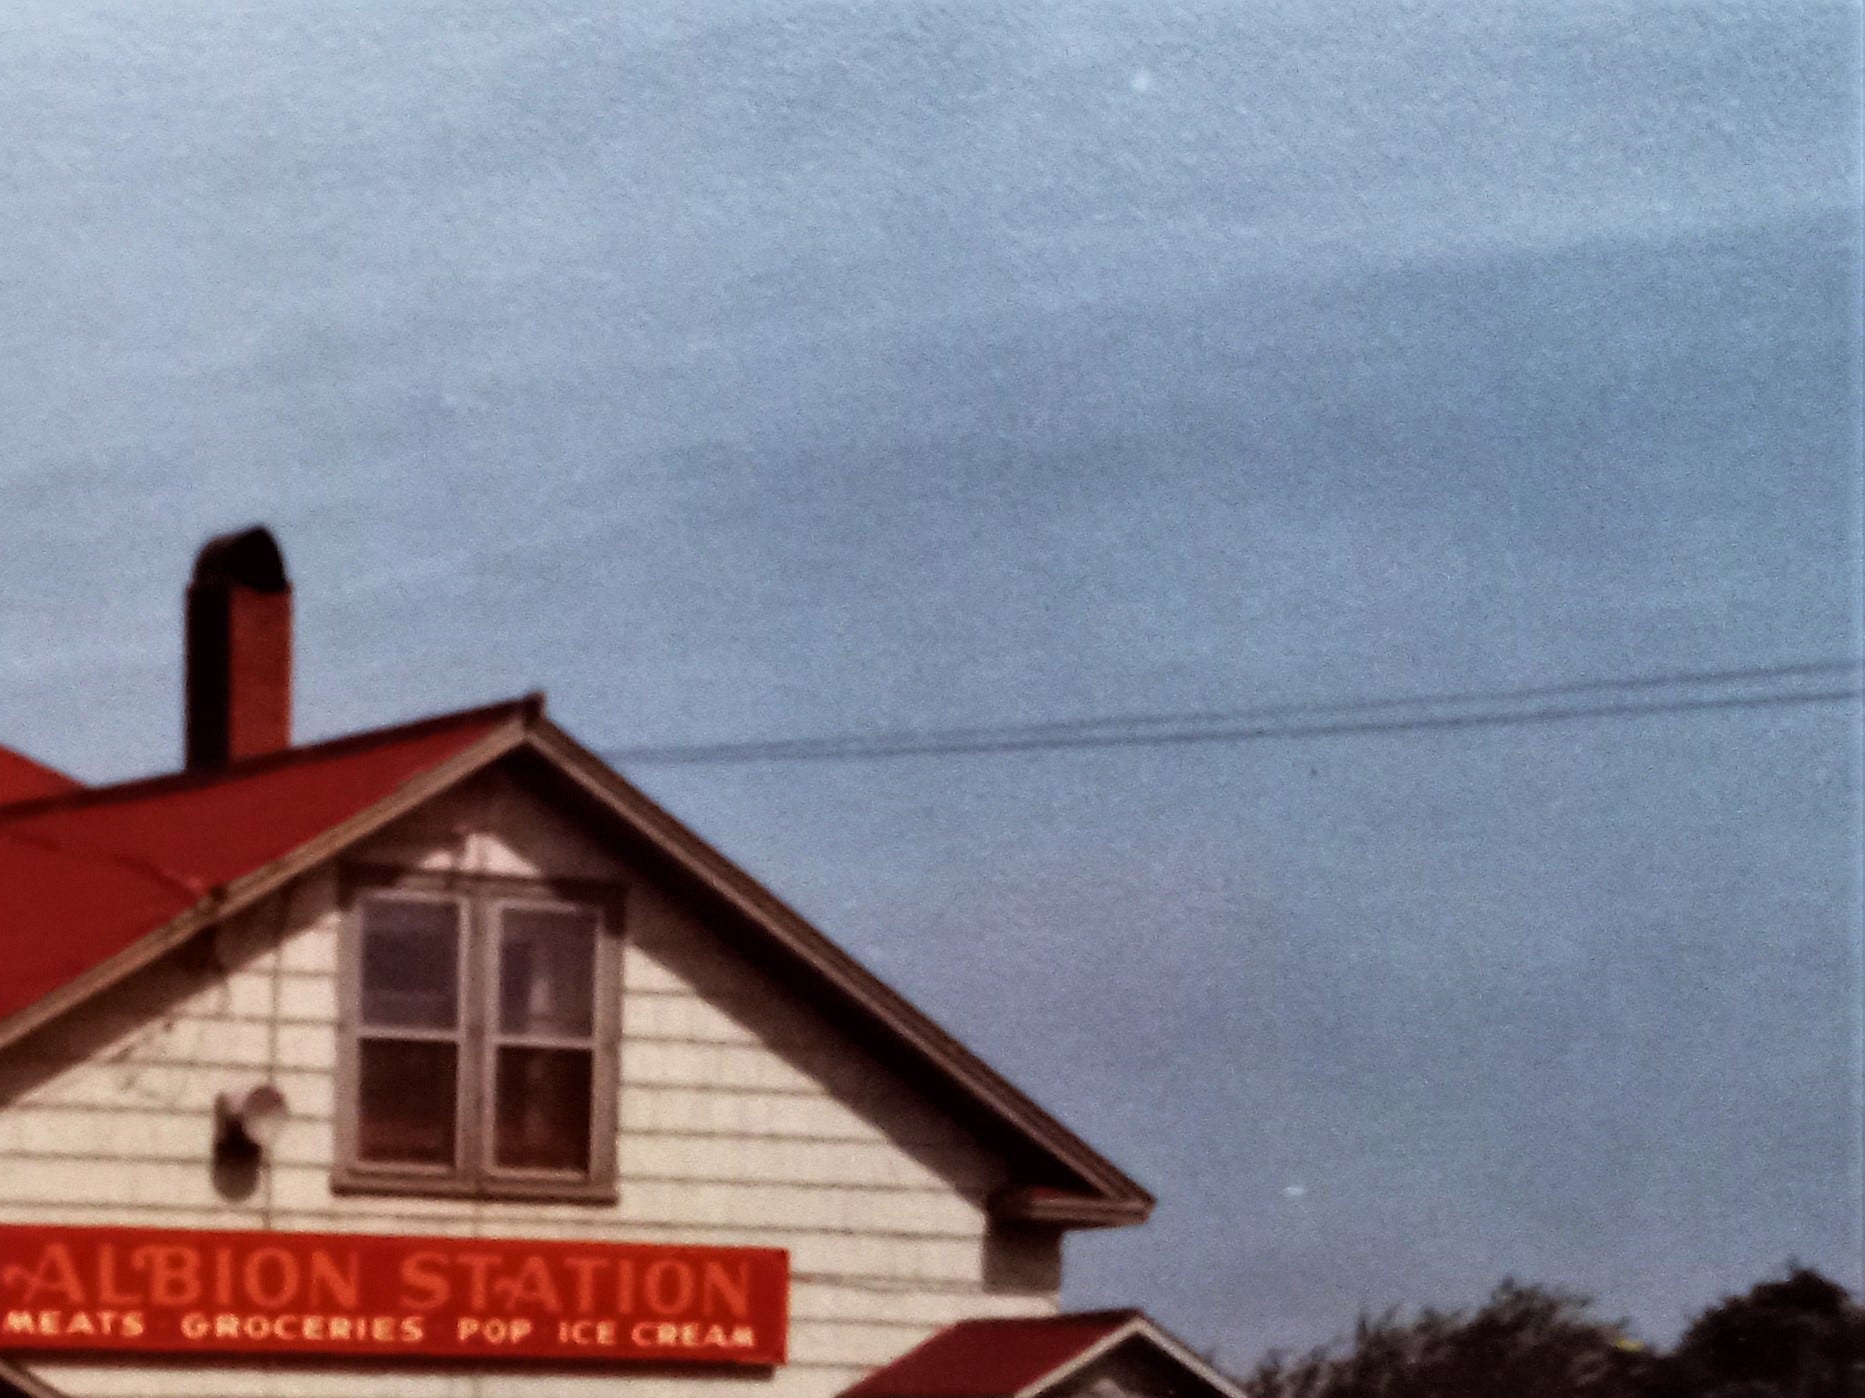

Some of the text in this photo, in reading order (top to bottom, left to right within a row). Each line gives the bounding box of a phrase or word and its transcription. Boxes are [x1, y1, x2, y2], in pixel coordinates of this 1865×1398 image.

[0, 1242, 750, 1317] ALBION STATION
[2, 1310, 754, 1348] MEATS GROCERIES POP ICE CREAM
